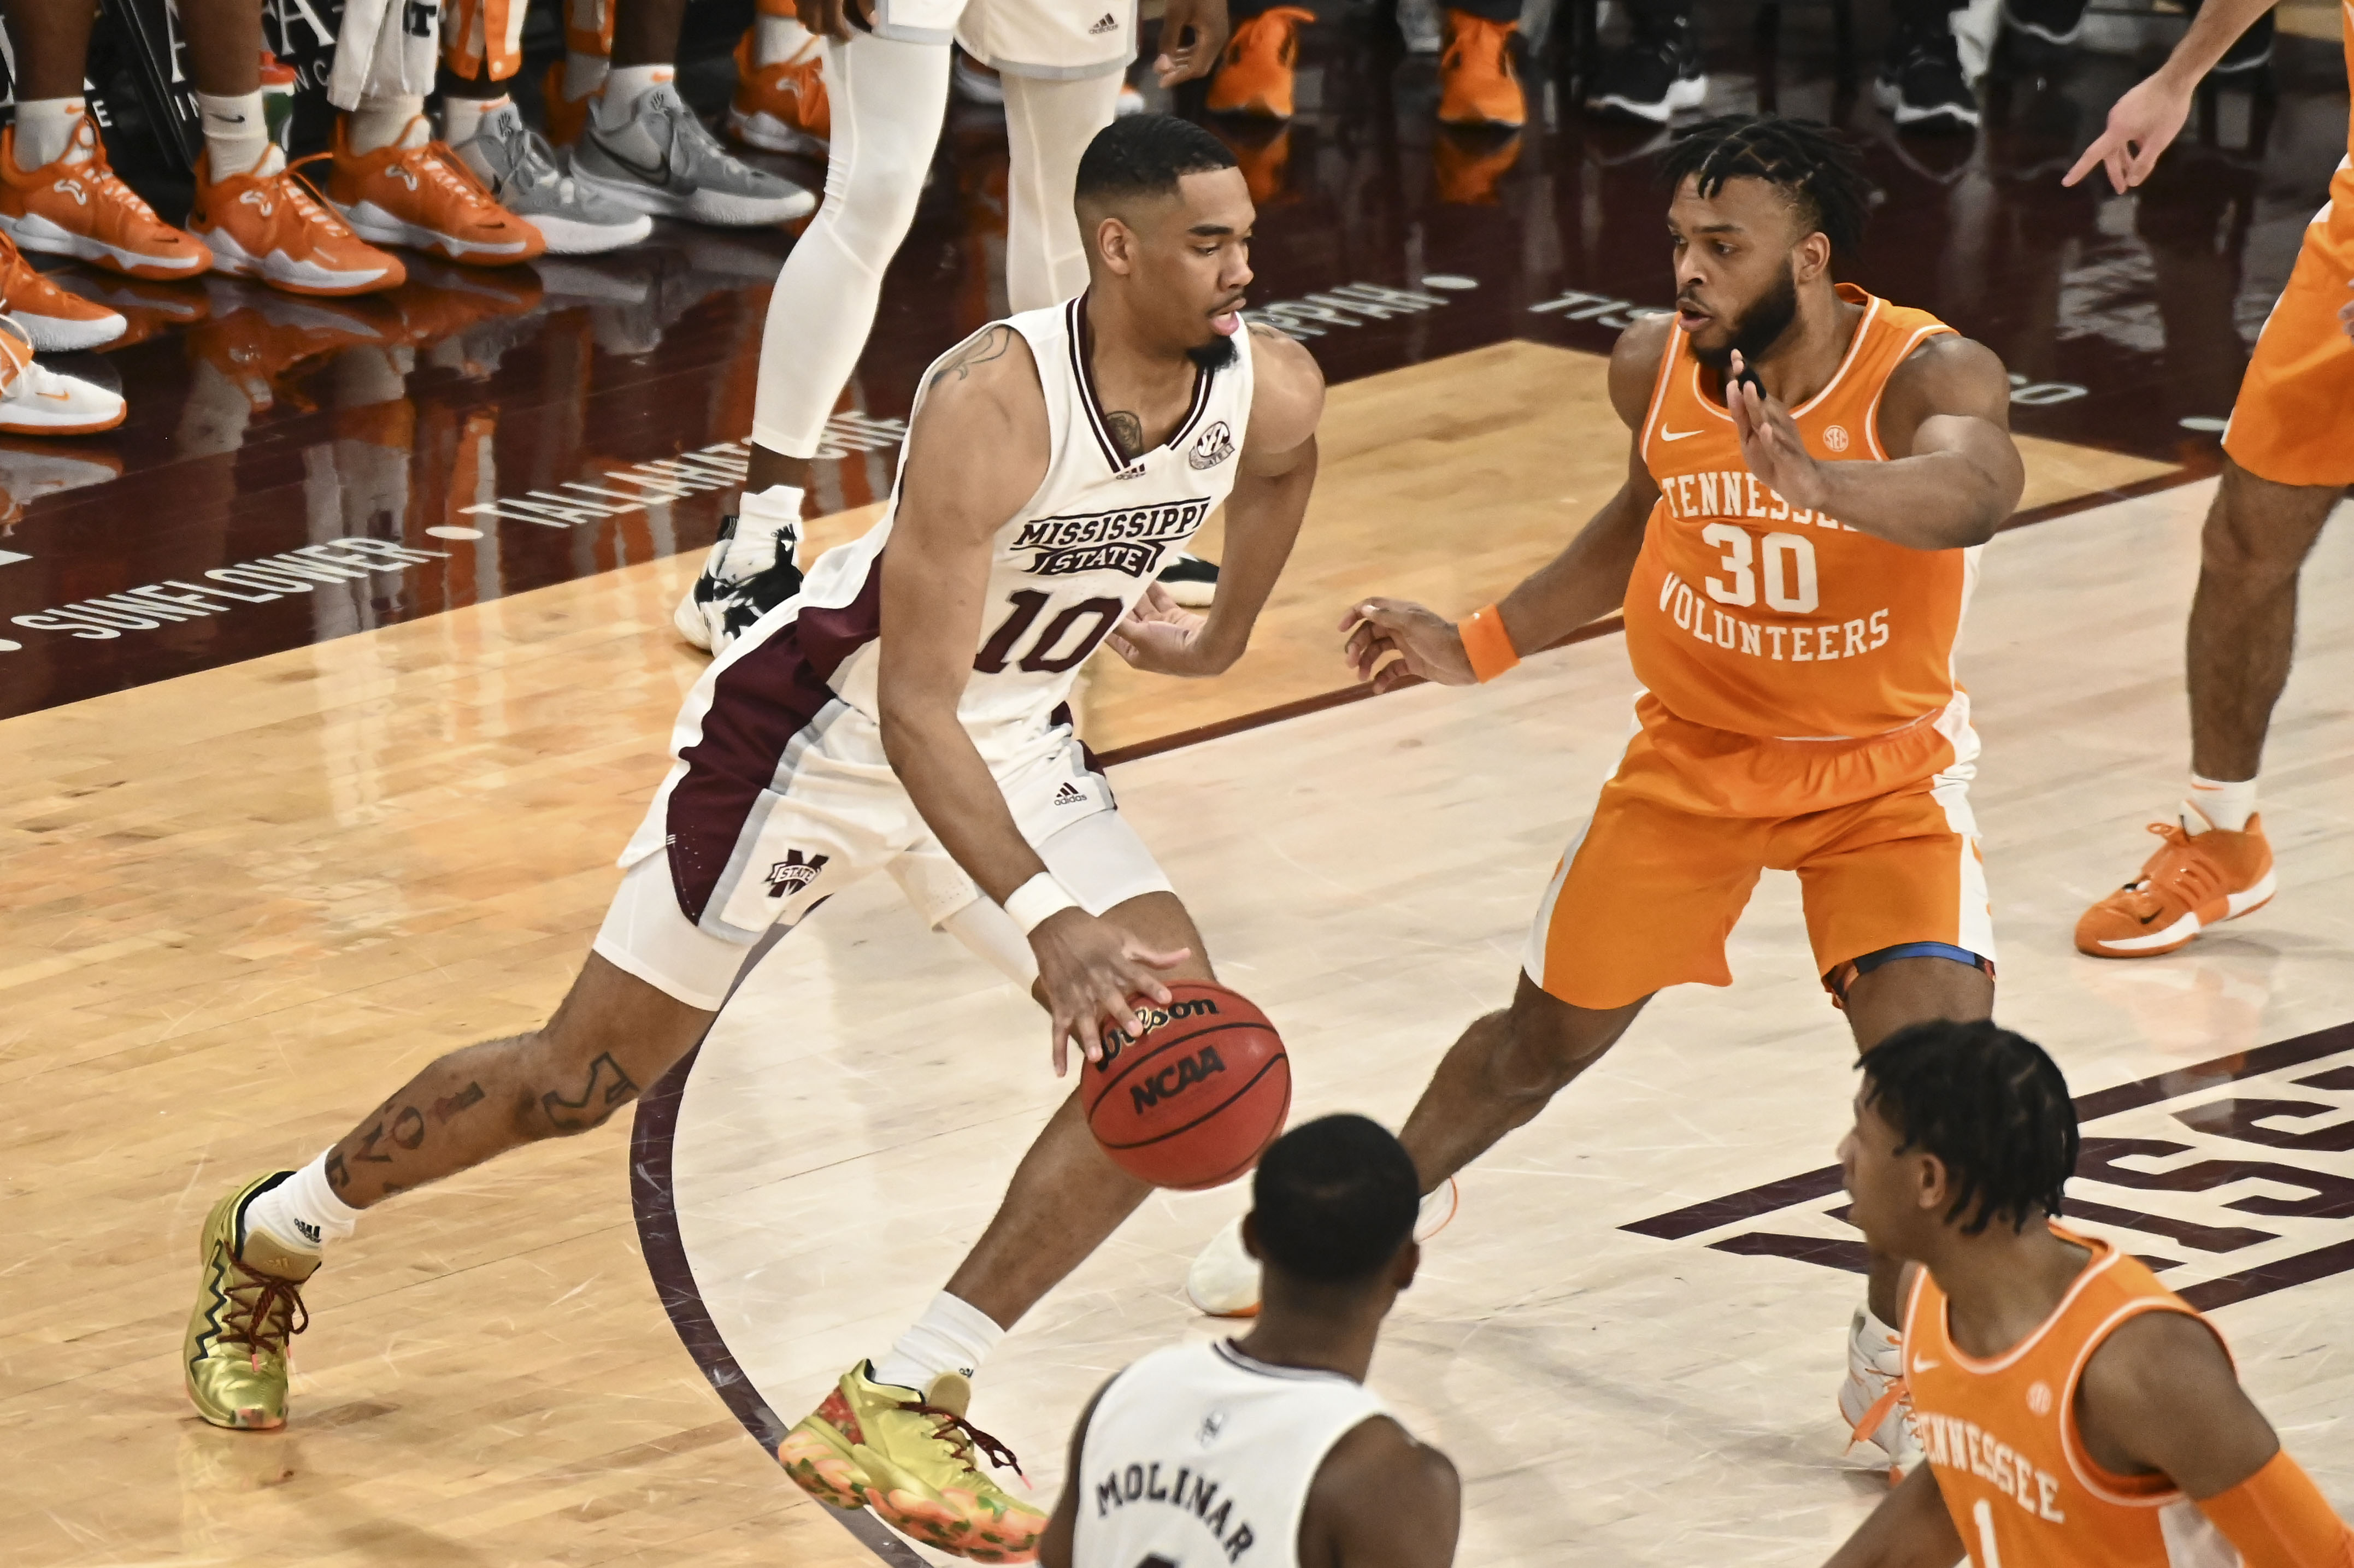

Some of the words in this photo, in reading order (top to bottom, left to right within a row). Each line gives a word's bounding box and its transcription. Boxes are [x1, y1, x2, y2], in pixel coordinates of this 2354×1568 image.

[1013, 502, 1209, 546] MISSISSIPPI
[1662, 471, 1860, 532] TENNES
[11, 538, 452, 640] SUNFLOWER
[1051, 547, 1143, 573] STATE
[1701, 522, 1820, 614] 30
[973, 589, 1123, 674] 10
[1659, 571, 1890, 662] VOLUNTEERS
[1054, 794, 1087, 806] adidas
[780, 866, 814, 882] STATE
[1129, 1044, 1226, 1115] NCAA
[1917, 1412, 2066, 1524] ENNESSEE
[1095, 1461, 1256, 1564] MOLINAR
[1973, 1499, 2002, 1568] 1
